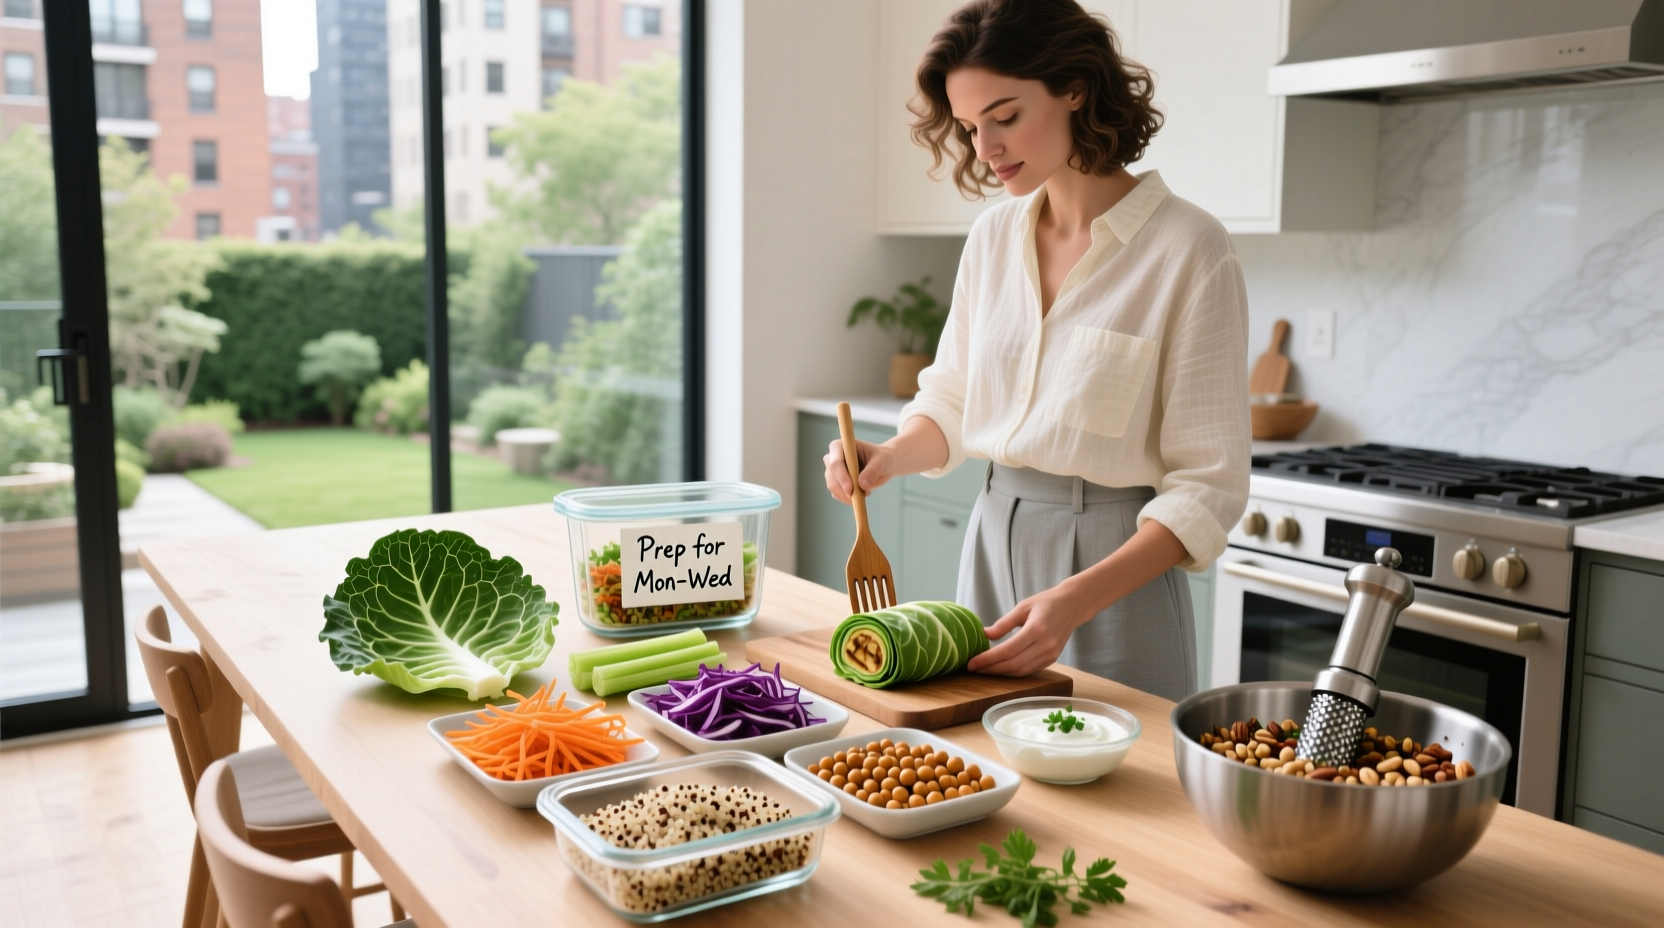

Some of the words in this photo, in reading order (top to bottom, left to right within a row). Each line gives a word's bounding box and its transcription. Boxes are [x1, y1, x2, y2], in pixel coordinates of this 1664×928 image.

[637, 535, 686, 567] Prep
[692, 533, 725, 558] for
[634, 564, 732, 593] Mon-Wed
